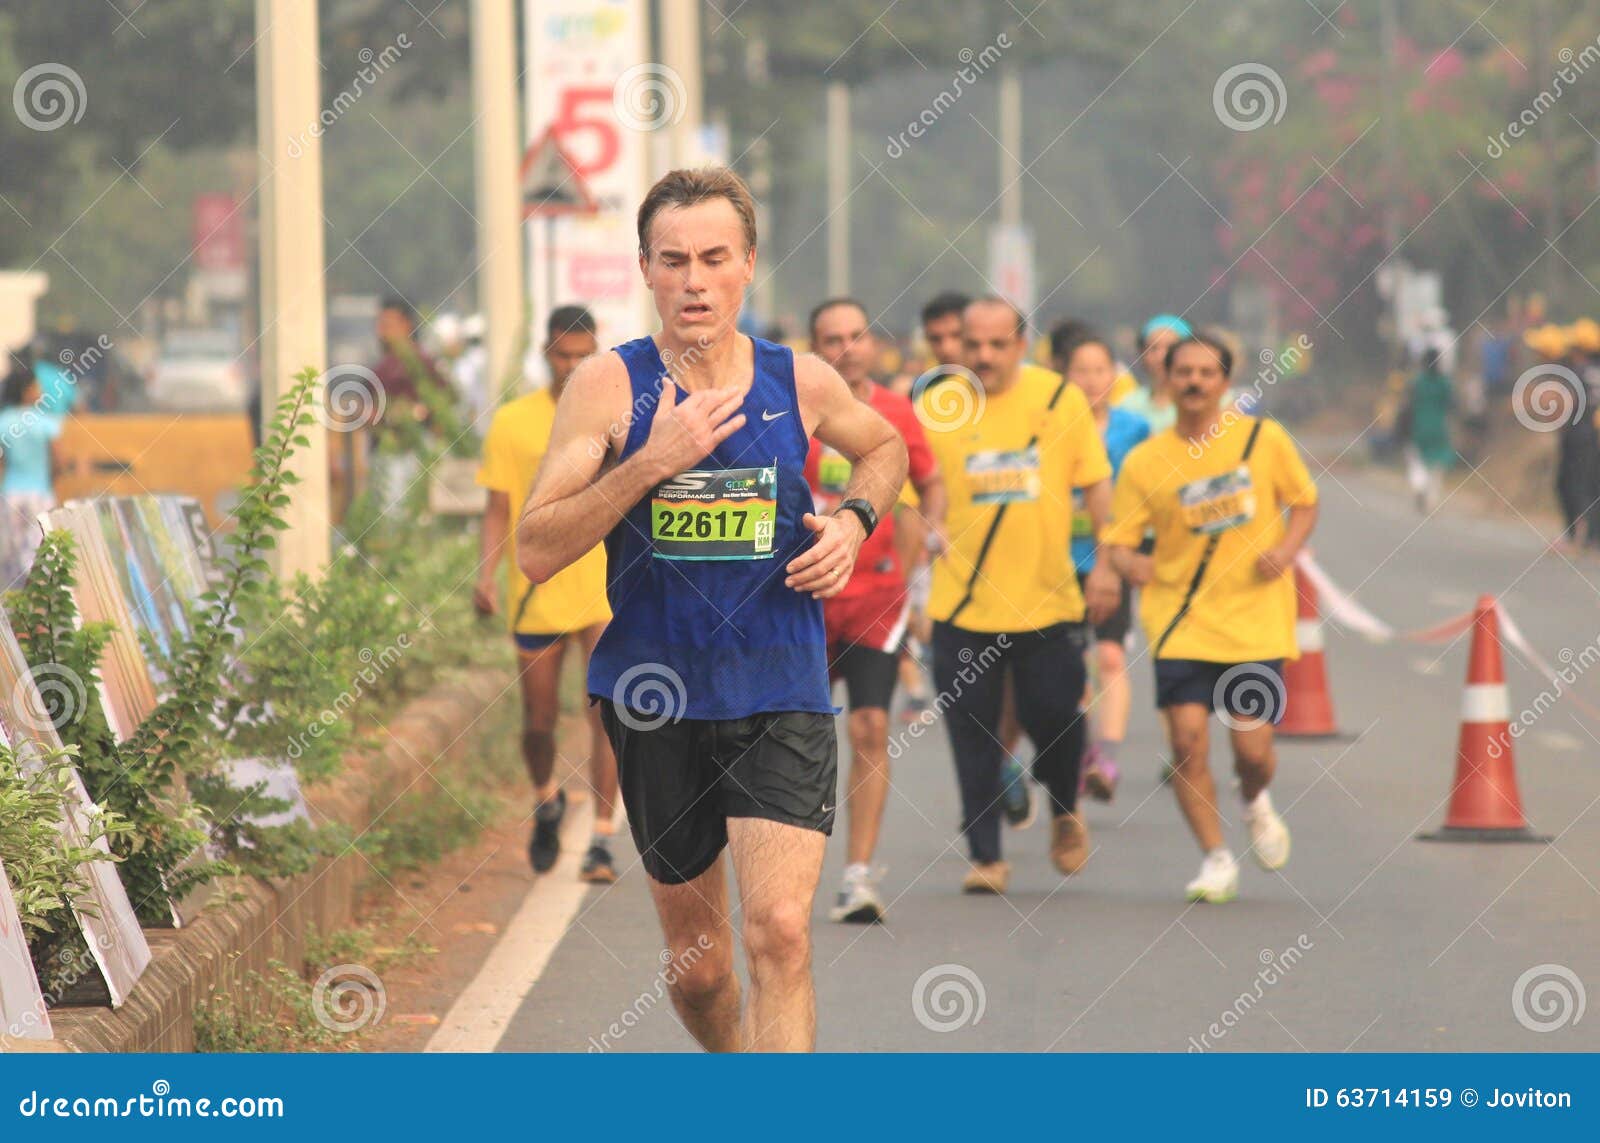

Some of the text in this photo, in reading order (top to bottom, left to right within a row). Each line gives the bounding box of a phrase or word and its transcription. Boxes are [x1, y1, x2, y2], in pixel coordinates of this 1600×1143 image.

[658, 510, 748, 538] 22617
[758, 522, 770, 535] 21
[757, 536, 770, 547] KM
